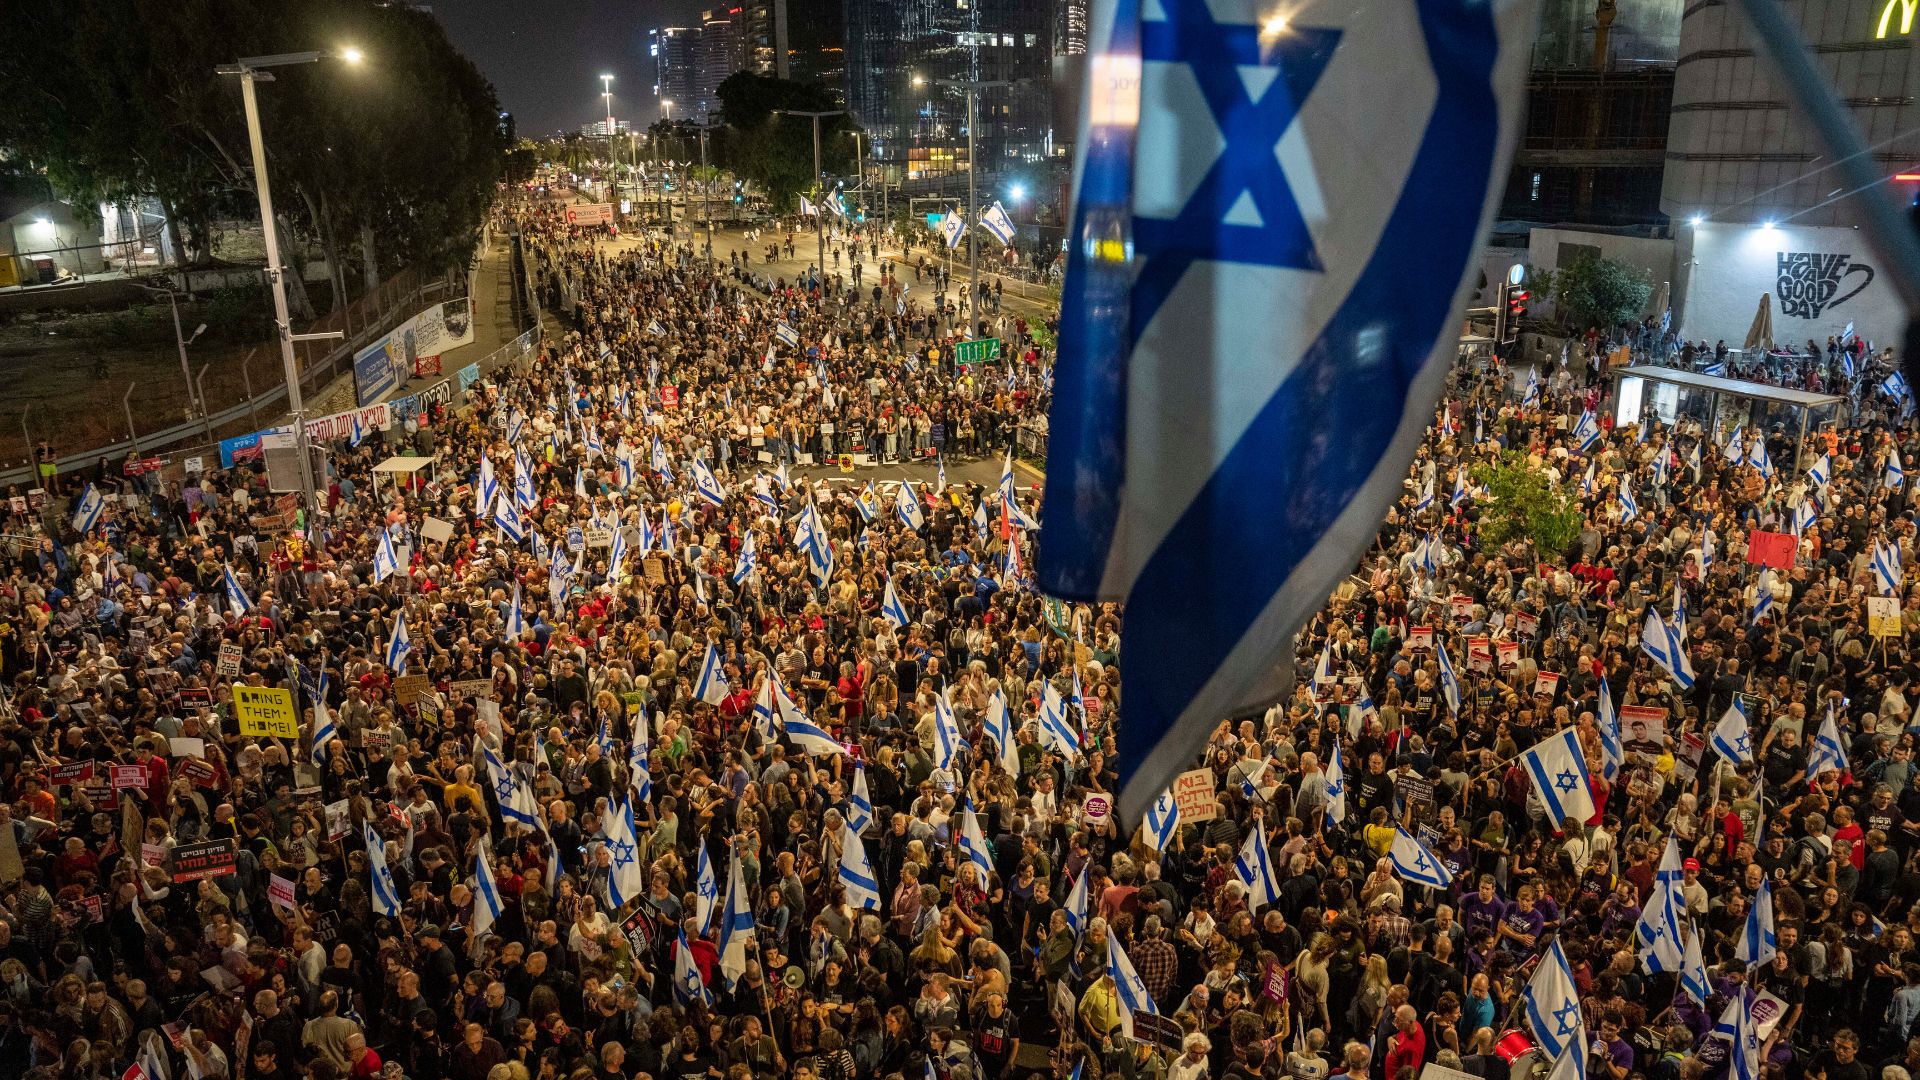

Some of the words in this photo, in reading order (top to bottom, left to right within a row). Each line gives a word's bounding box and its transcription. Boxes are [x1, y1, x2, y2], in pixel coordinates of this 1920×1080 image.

[1777, 275, 1838, 304] GOOD
[1781, 299, 1829, 320] DAY
[247, 720, 291, 734] HOME!
[181, 848, 203, 858] שבויים
[204, 845, 225, 855] פדיון
[175, 856, 207, 870] מחיר
[210, 853, 233, 865] בכל
